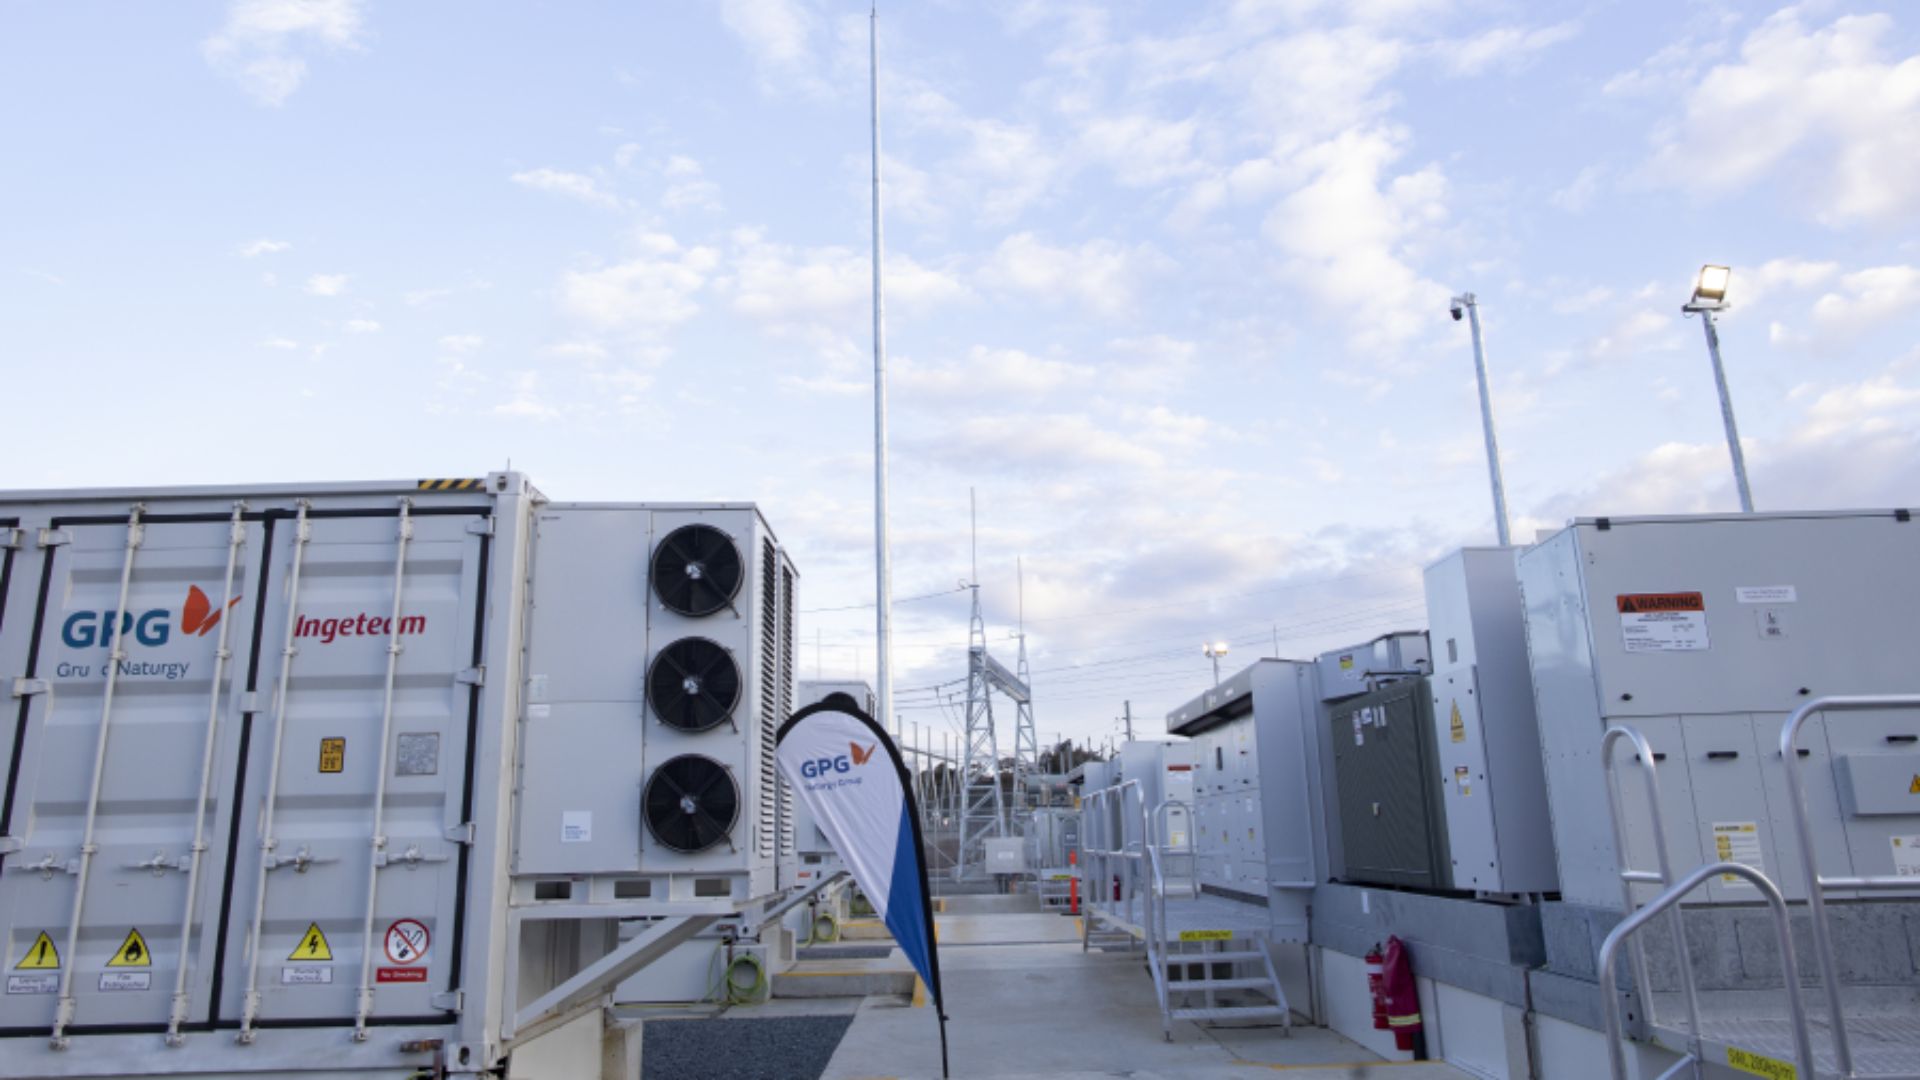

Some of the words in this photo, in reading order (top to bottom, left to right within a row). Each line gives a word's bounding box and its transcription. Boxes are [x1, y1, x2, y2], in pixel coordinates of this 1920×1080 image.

[1636, 596, 1699, 609] WARNING
[62, 608, 171, 649] GPG
[117, 660, 190, 679] Naturgy
[801, 755, 850, 778] GPG
